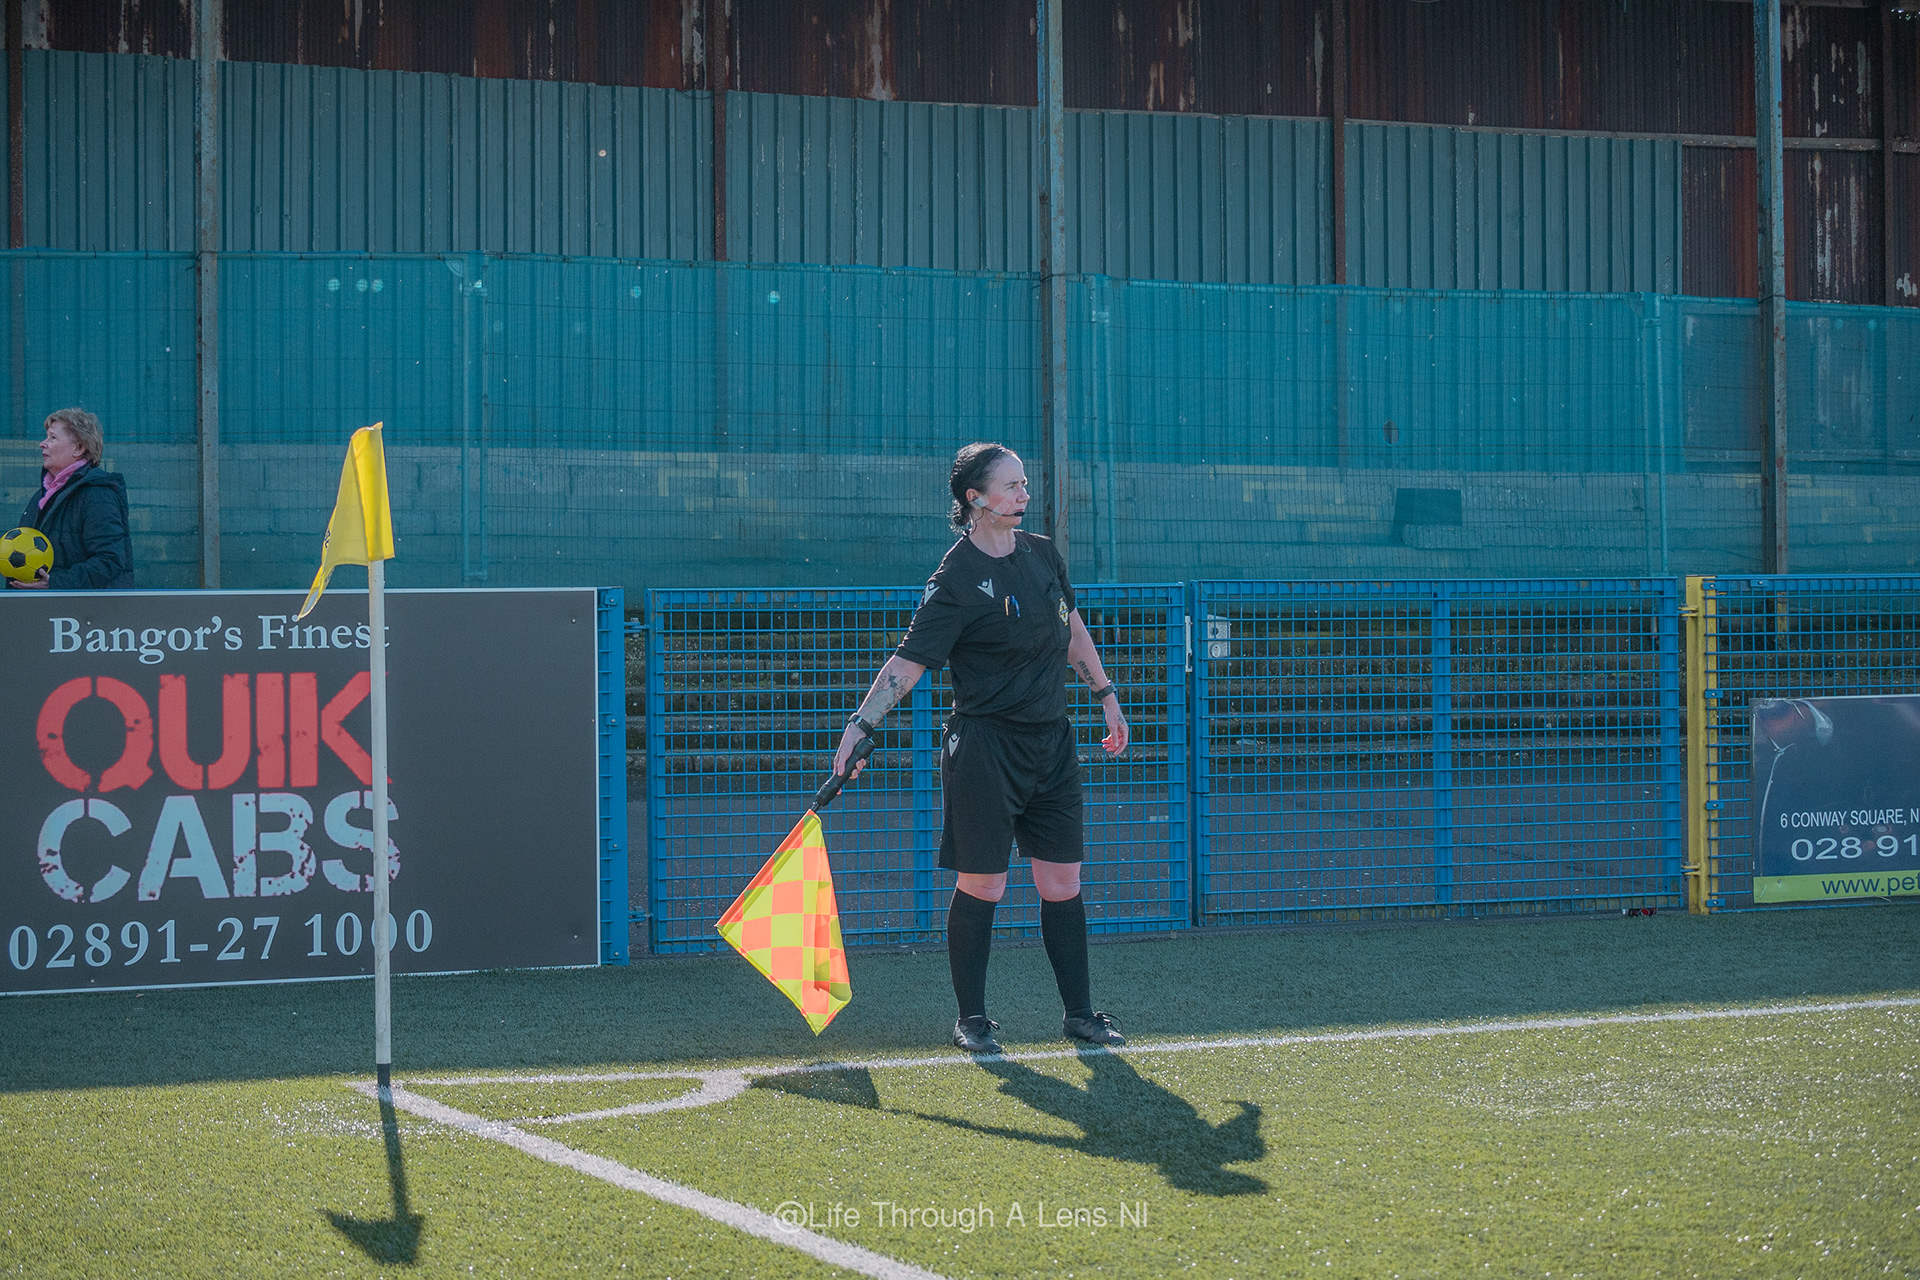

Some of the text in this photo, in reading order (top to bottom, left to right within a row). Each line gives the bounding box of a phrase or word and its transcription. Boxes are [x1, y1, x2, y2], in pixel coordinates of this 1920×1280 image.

[48, 613, 390, 665] Bangor's Fines
[36, 671, 394, 793] QUIK
[1780, 812, 1788, 829] 6
[1791, 810, 1847, 828] CONWAY
[1850, 808, 1907, 826] SQUARE,
[37, 790, 401, 903] CABS
[1791, 833, 1918, 861] 028 91
[8, 916, 281, 971] 02891-27
